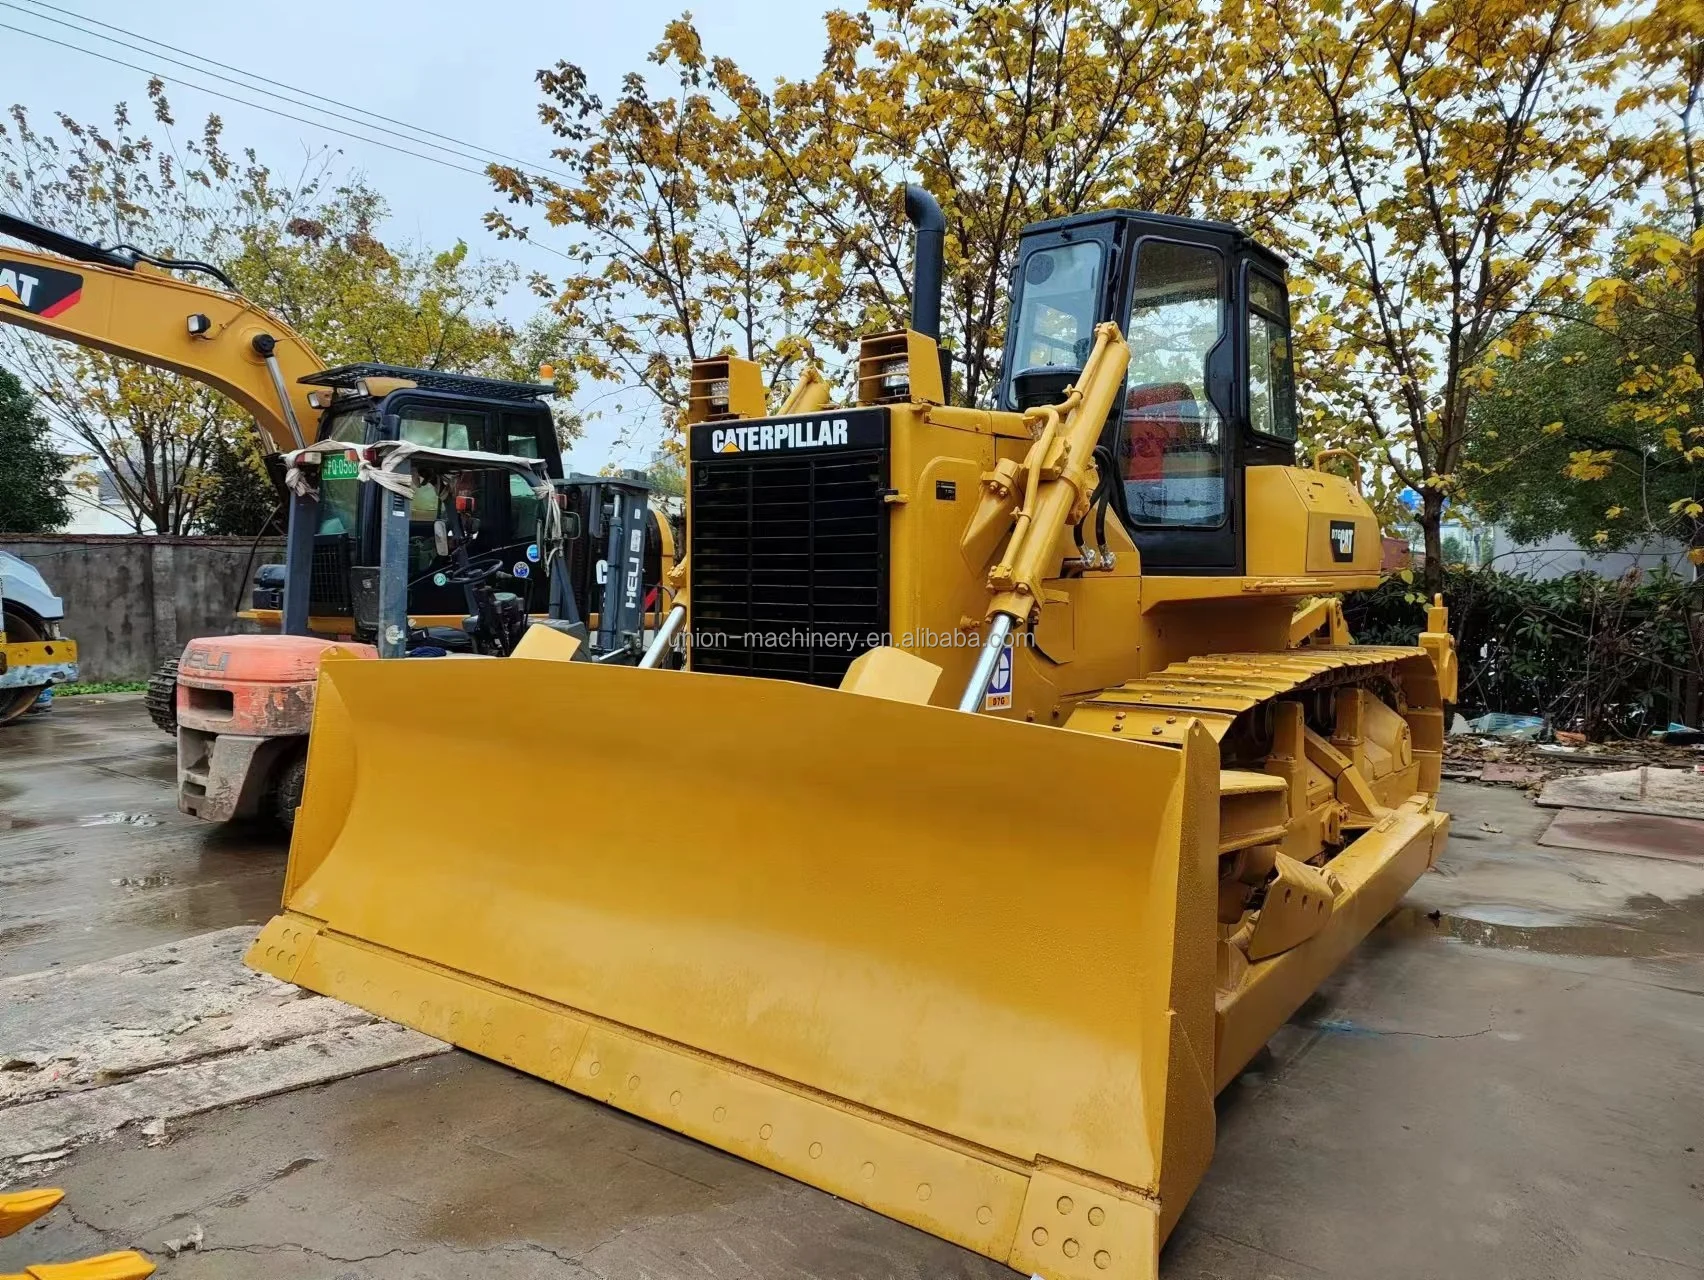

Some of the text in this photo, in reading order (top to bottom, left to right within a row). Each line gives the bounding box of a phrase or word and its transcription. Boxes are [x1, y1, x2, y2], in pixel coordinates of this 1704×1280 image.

[0, 267, 39, 307] AT
[712, 419, 848, 453] CATERPILLAR
[1340, 529, 1353, 553] CAT
[625, 557, 640, 608] HELI
